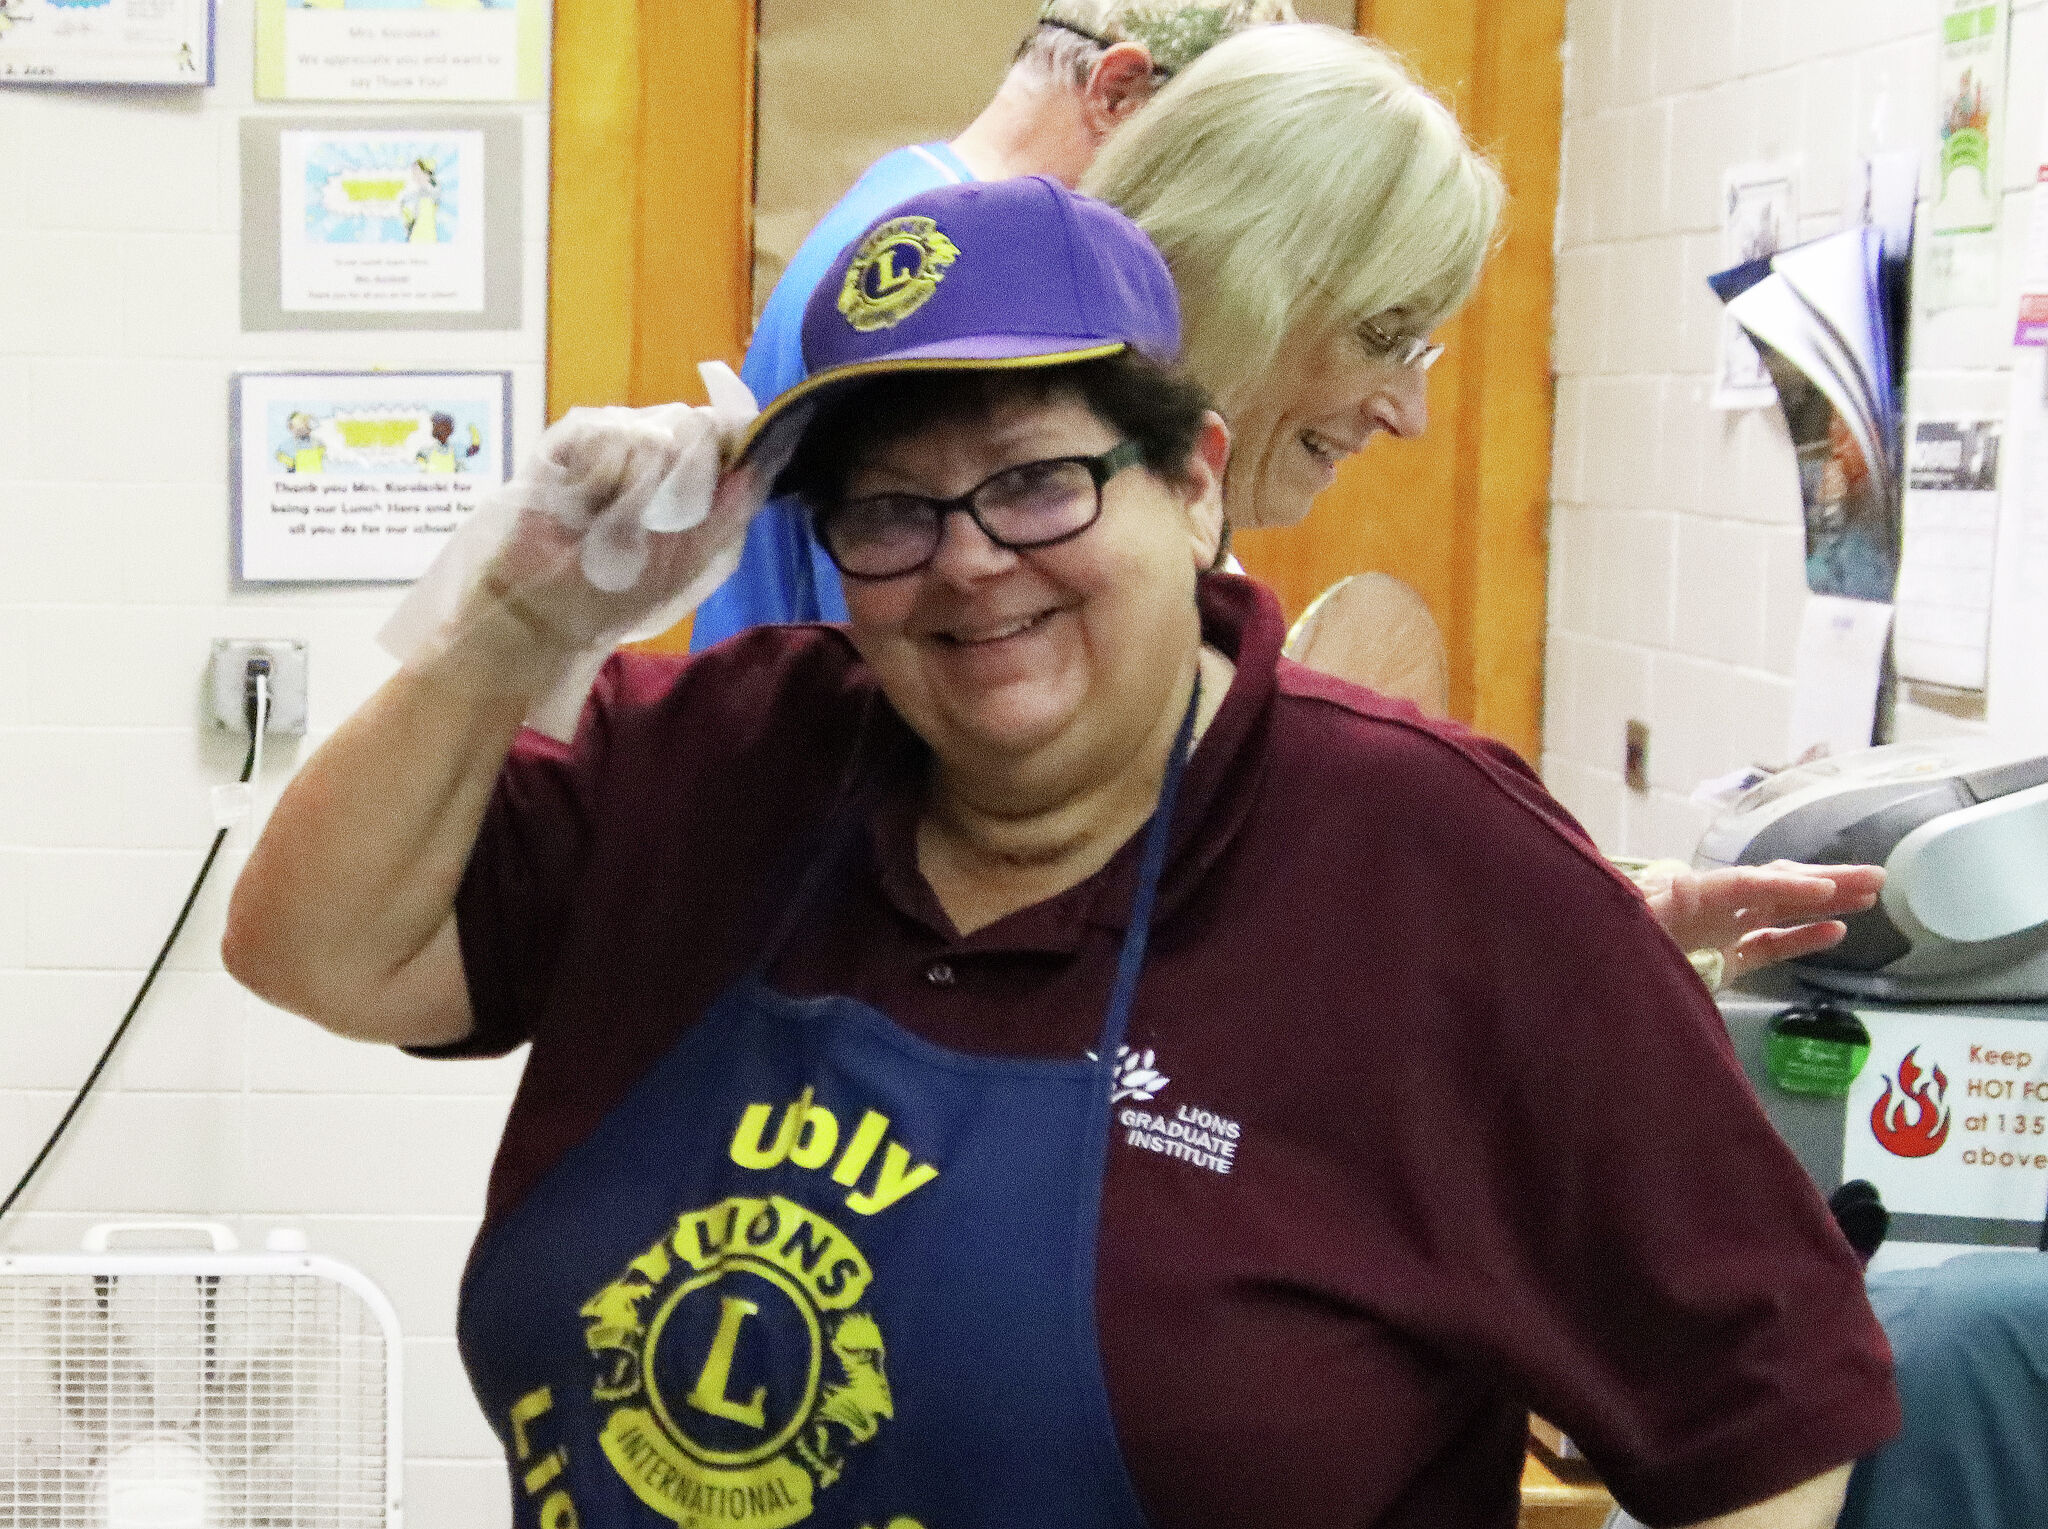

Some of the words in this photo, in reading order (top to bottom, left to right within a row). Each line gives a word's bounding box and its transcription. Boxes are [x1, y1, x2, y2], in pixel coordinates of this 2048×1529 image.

[875, 250, 912, 292] L
[274, 481, 317, 493] Thank
[322, 484, 348, 495] you
[271, 502, 310, 516] being
[313, 504, 336, 514] our
[341, 502, 382, 514] Lunch
[387, 502, 420, 514] Hero
[426, 502, 452, 514] and
[288, 522, 306, 534] all
[310, 525, 335, 536] you
[360, 523, 380, 534] for
[385, 525, 408, 534] our
[1968, 1044, 2033, 1071] Keep
[1967, 1078, 2015, 1100] HOT
[1119, 1109, 1238, 1158] GRADUATE
[1177, 1104, 1241, 1139] LIONS
[1964, 1113, 1988, 1132] at
[1127, 1130, 1234, 1174] INSTITUTE
[1961, 1146, 2048, 1170] above
[695, 1204, 860, 1299] LIONS
[687, 1296, 768, 1430] L
[617, 1428, 799, 1522] INTERNATIONAL
